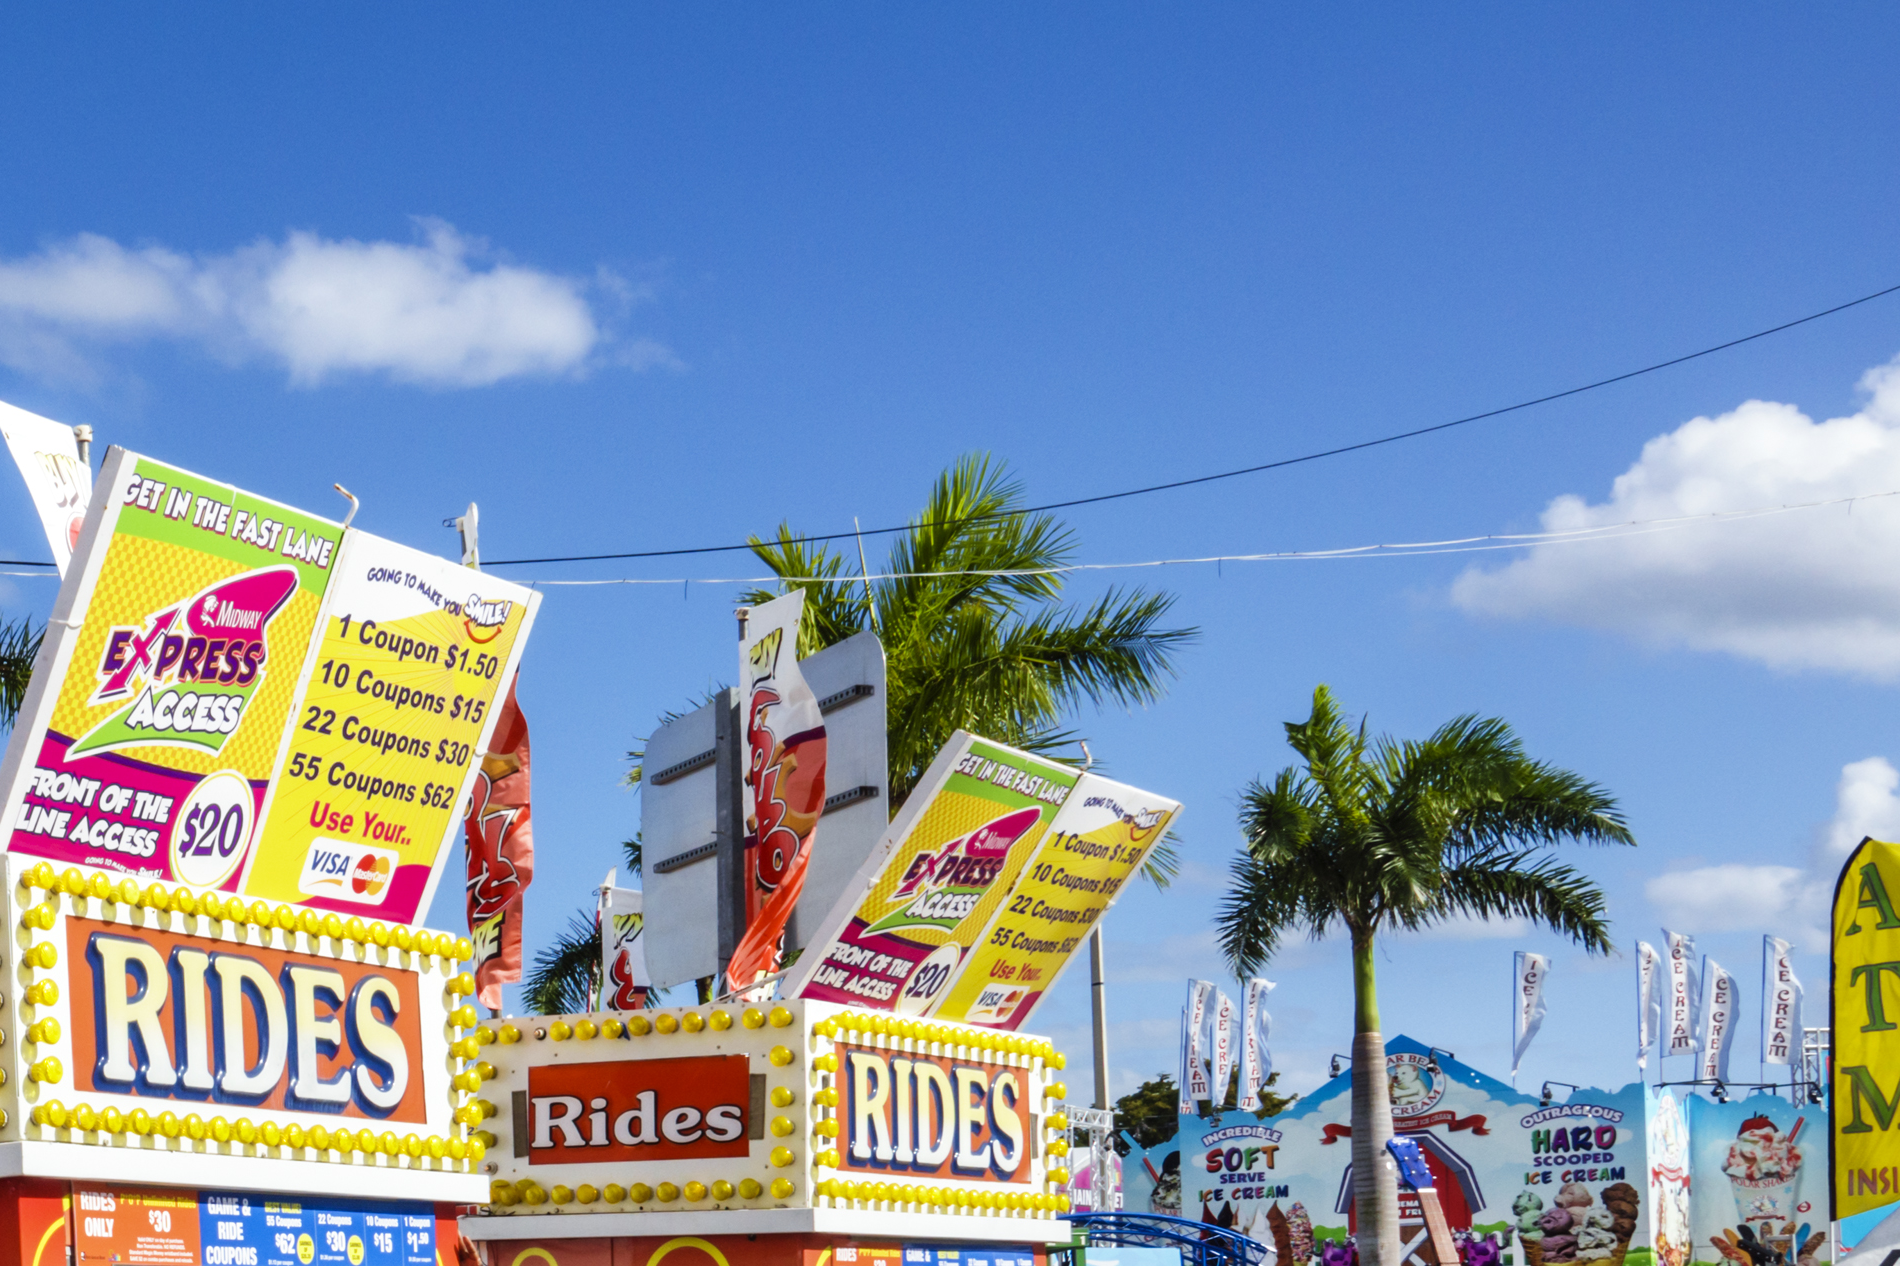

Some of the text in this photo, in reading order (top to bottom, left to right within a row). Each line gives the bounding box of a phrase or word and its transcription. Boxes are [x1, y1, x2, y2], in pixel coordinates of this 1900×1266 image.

[122, 474, 166, 511] GET
[165, 487, 192, 520] IN
[192, 497, 230, 536] THE
[231, 510, 283, 552] FAST
[282, 526, 335, 570] LANE
[367, 567, 512, 628] GOING TO MAKE YOU SMILE!
[97, 606, 264, 698] EXPRESS
[340, 614, 498, 680] 1 Coupon $1.50
[126, 686, 243, 734] ACCESS
[321, 660, 485, 724] 10 Coupons $15
[303, 706, 469, 767] 22 Coupons $30
[25, 767, 173, 825] FRONT OF THE
[289, 753, 454, 810] 55 Coupons $62
[15, 803, 158, 860] LINE ACCESS
[179, 802, 244, 858] $20
[309, 800, 353, 834] Use
[310, 849, 351, 876] VISA
[906, 893, 979, 920] ACCESS
[905, 963, 950, 997] $20
[90, 932, 415, 1113] RIDES
[531, 1089, 744, 1149] Rides
[846, 1049, 1021, 1180] RIDES
[1201, 1125, 1283, 1147] INCREDIBLE
[1521, 1104, 1624, 1128] OUTRAGEOUS
[1531, 1125, 1616, 1154] HARD
[1206, 1145, 1279, 1173] SOFT
[1220, 1172, 1265, 1184] SERVE
[1524, 1167, 1625, 1185] ICE CREAM
[1534, 1153, 1614, 1167] SCOOPED
[1198, 1185, 1289, 1202] ICE CREAM
